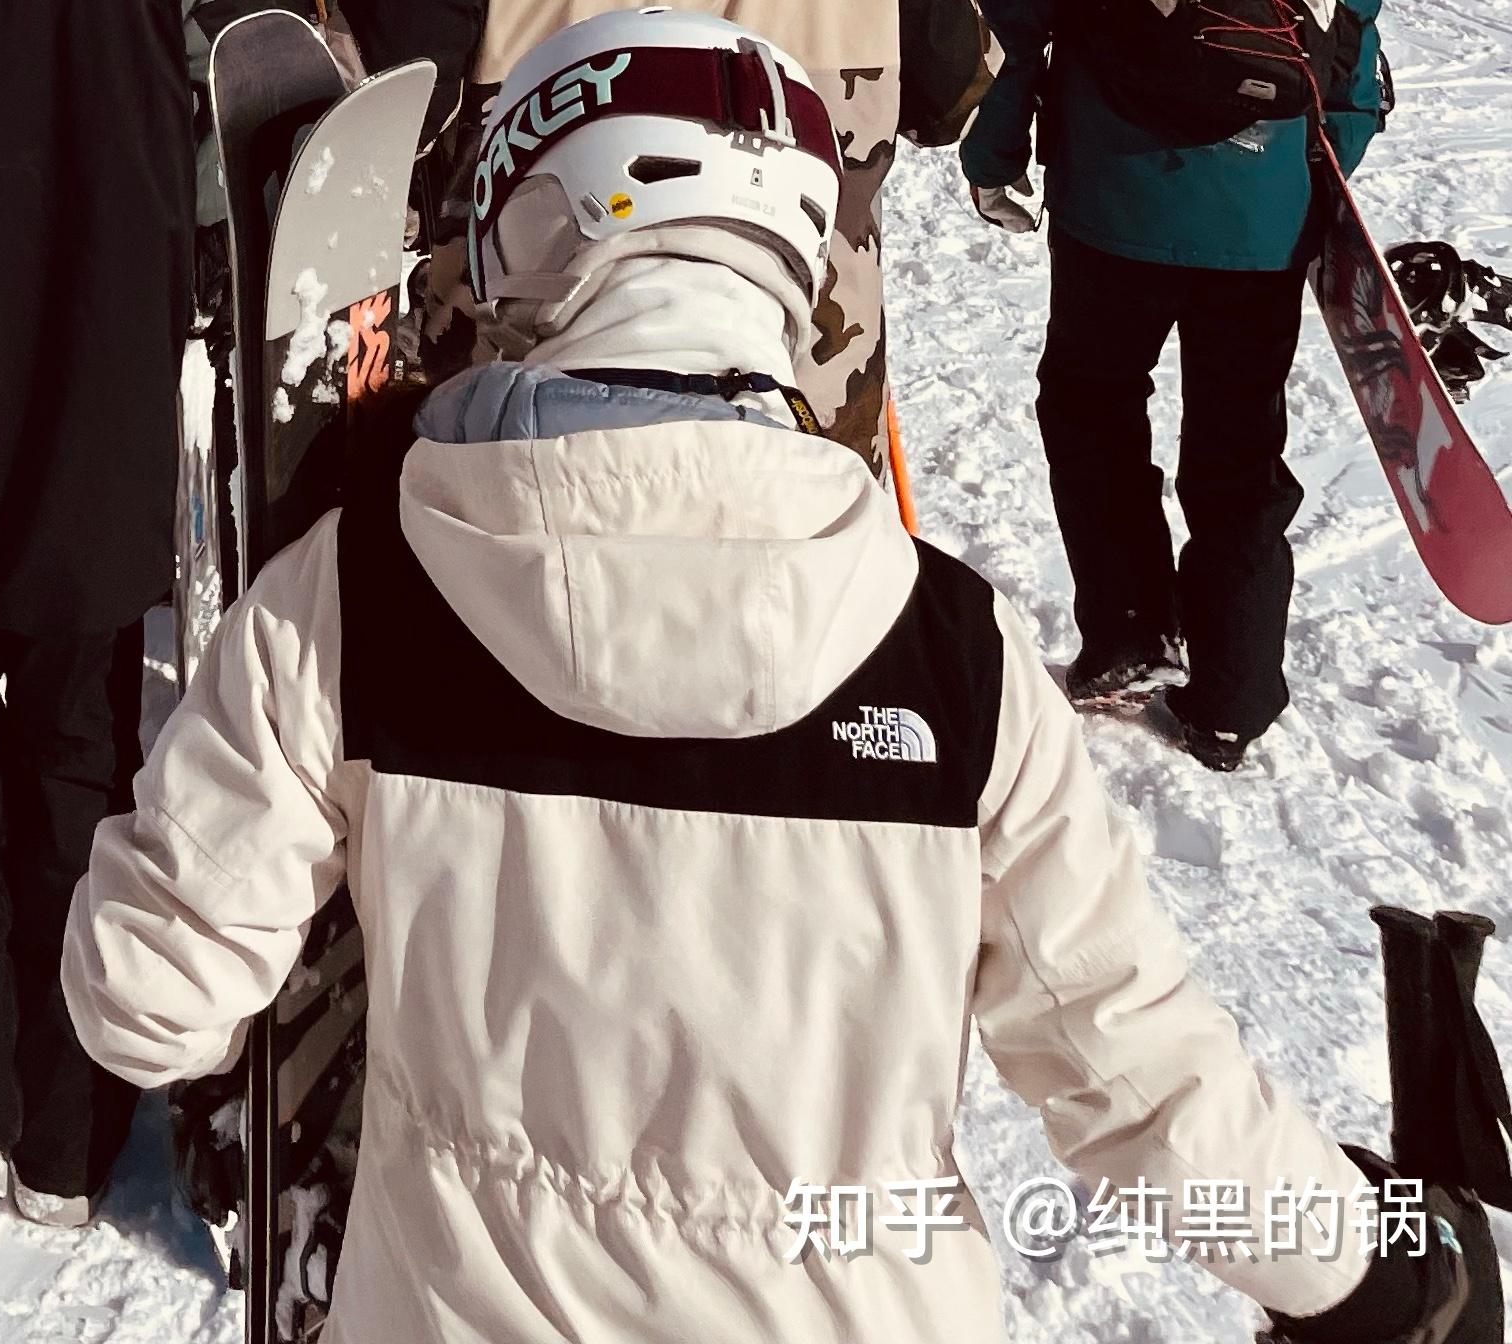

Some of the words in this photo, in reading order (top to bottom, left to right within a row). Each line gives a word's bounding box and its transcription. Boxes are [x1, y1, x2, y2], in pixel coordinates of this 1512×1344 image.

[473, 52, 632, 221] OAKLEY
[858, 705, 899, 726] THE
[831, 720, 900, 743] NORTH
[852, 740, 902, 760] FACE
